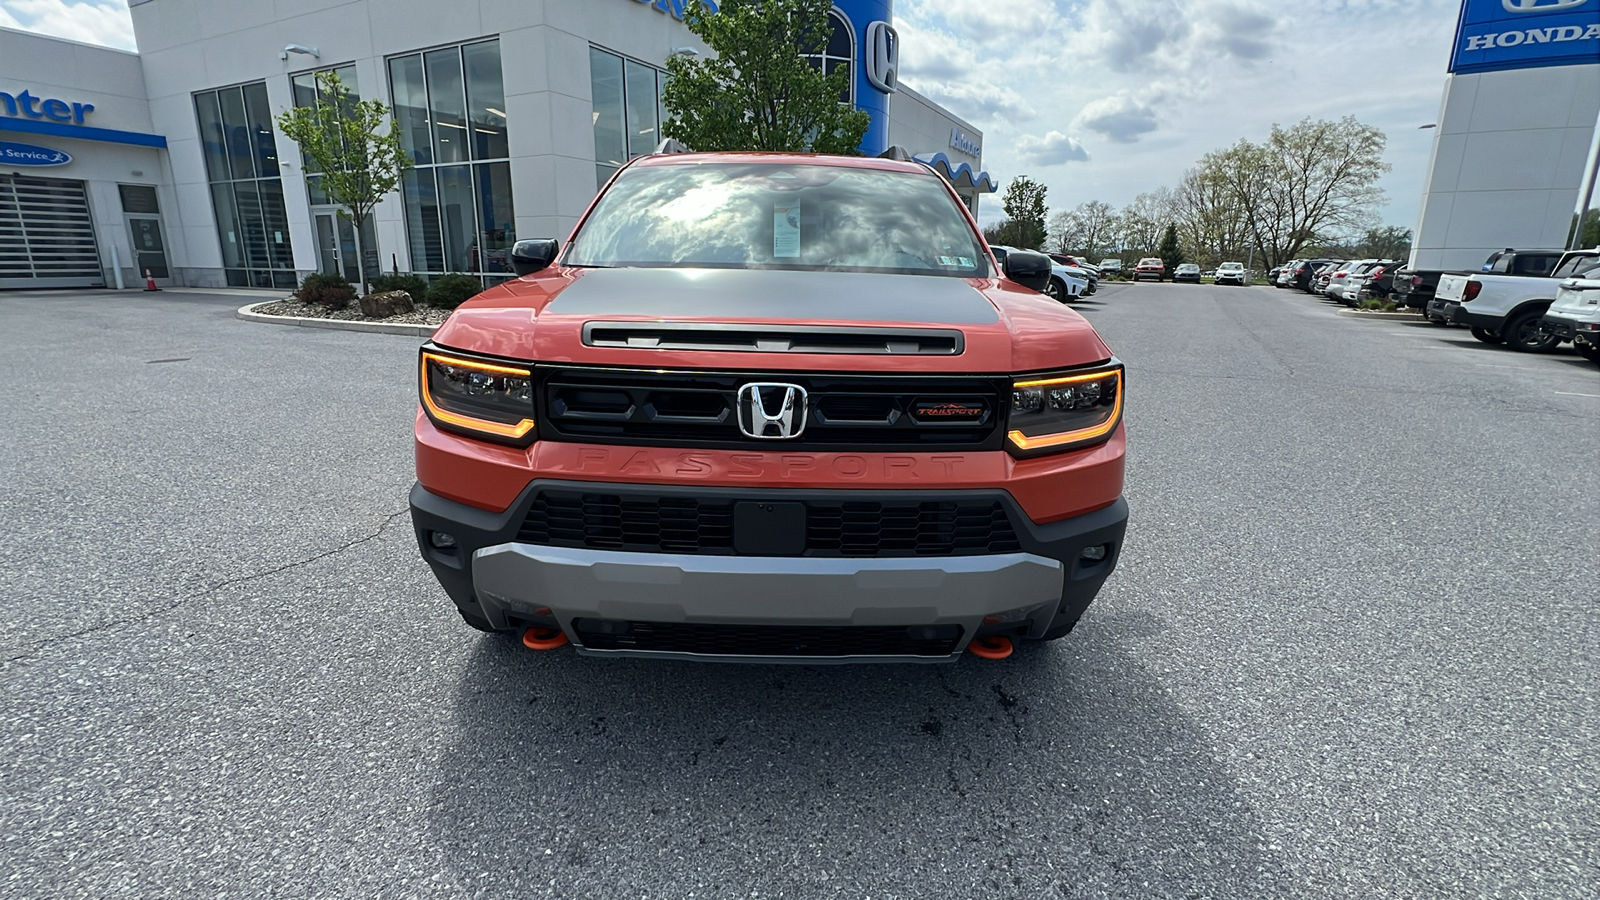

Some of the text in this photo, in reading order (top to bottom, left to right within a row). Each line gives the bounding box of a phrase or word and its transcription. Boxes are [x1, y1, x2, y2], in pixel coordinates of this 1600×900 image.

[1465, 24, 1600, 51] HONDA
[6, 149, 49, 160] Service
[577, 447, 964, 480] PASSPORT
